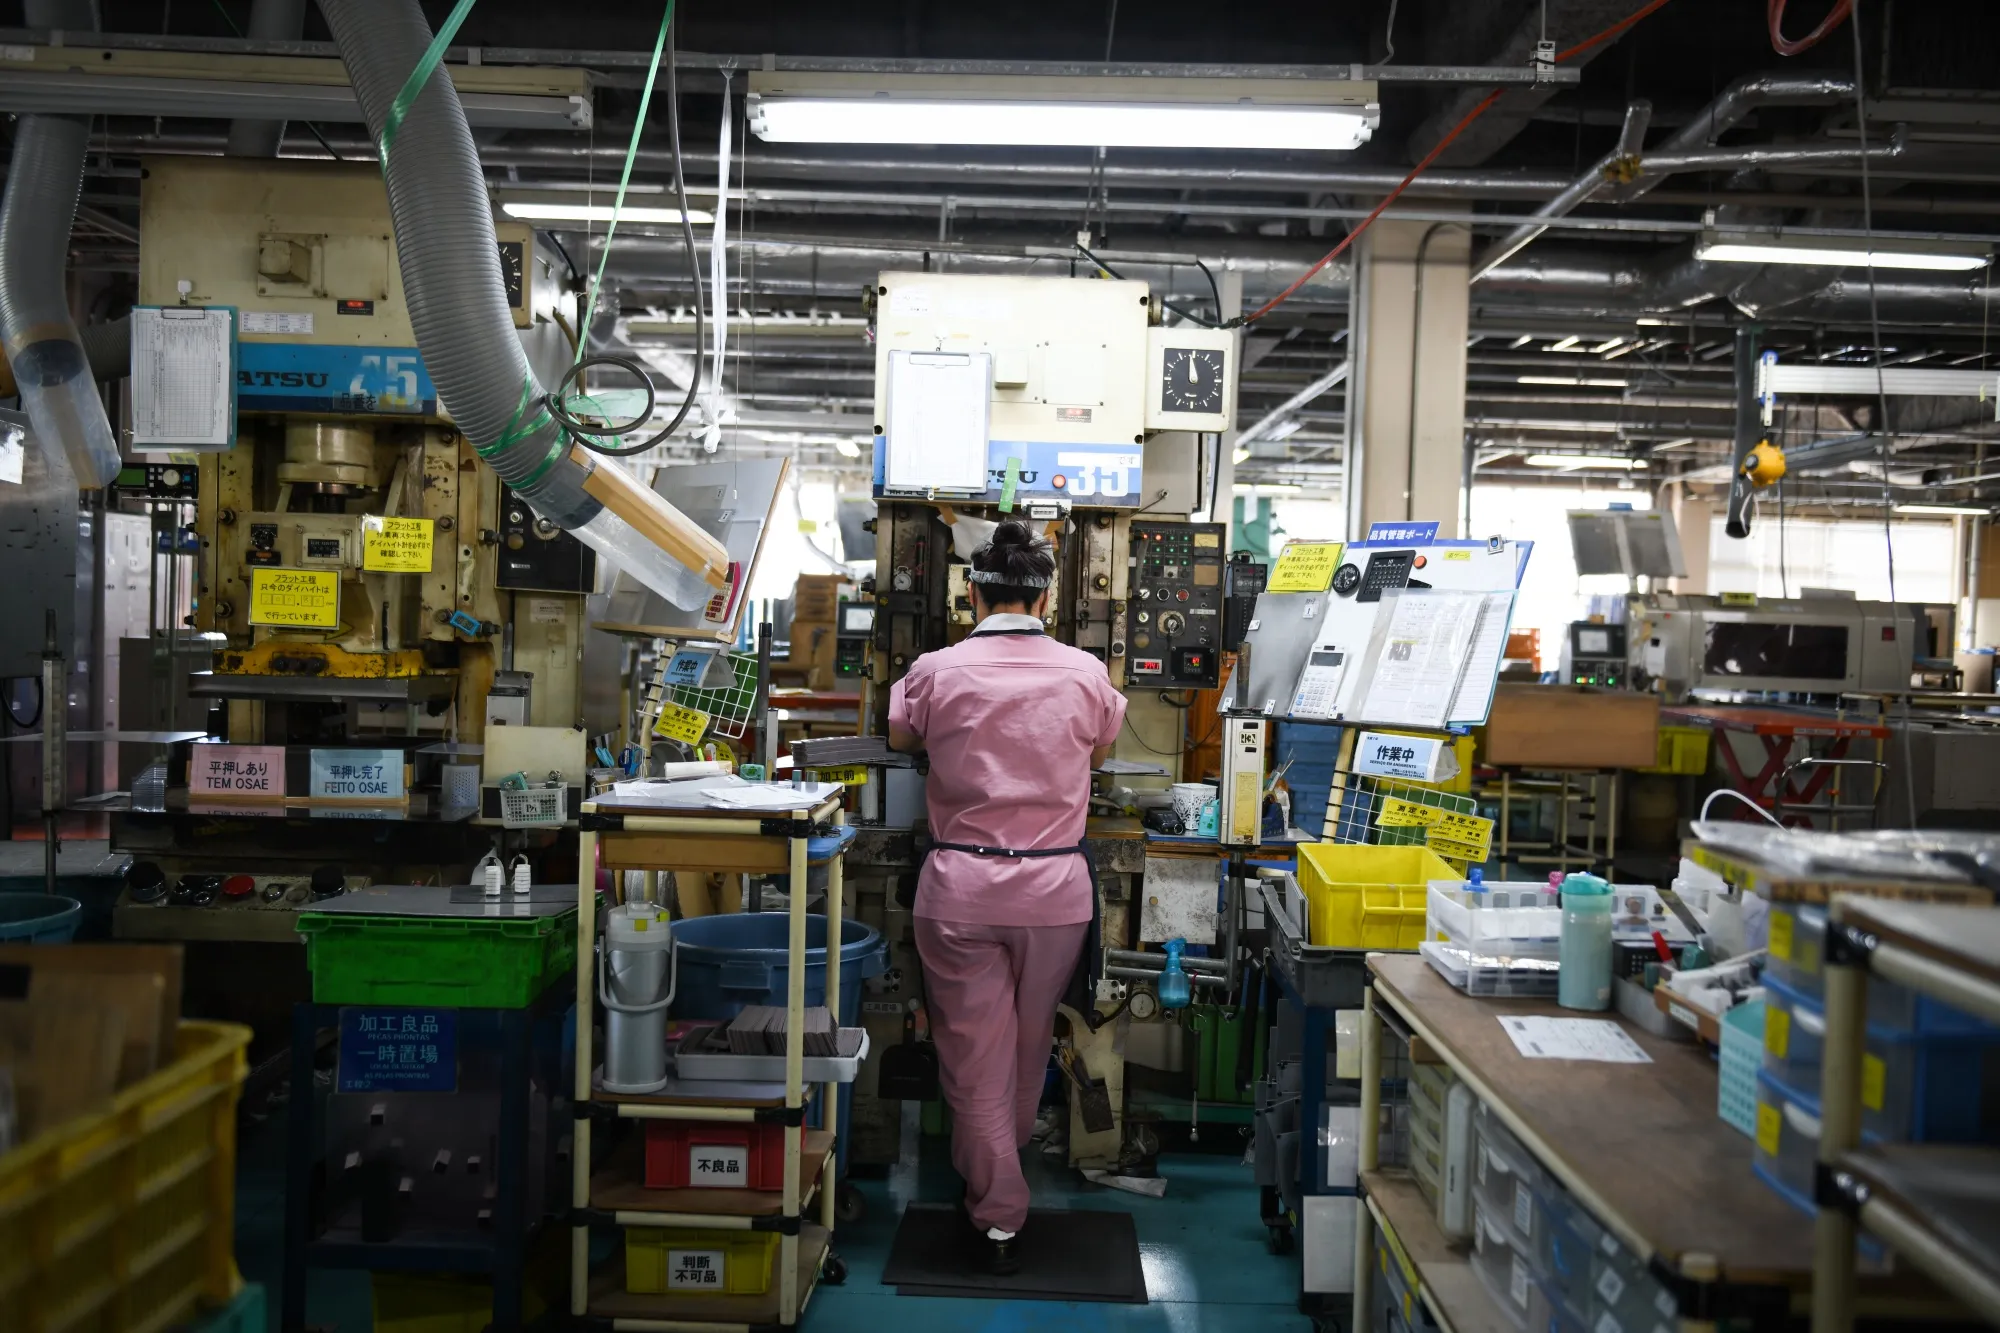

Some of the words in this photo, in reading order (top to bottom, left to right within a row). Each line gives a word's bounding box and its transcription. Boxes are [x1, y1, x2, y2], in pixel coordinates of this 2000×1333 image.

[350, 356, 417, 406] 45
[1068, 466, 1128, 497] 35
[387, 521, 422, 531] フラット工程
[1369, 529, 1434, 541] 品質管理ボード
[274, 574, 317, 585] フラット工程
[260, 583, 331, 594] 只今のダイハイトは
[263, 611, 322, 622] で行っています。
[1376, 744, 1415, 763] 作業中
[209, 760, 268, 776] 平押しあり
[329, 765, 384, 780] 平押し完了
[820, 769, 855, 781] 加工前
[206, 777, 232, 789] TEM
[235, 778, 269, 790] OSAE
[324, 781, 355, 794] FEITO
[359, 782, 388, 794] OSAE
[1396, 804, 1429, 817] 測定中
[1445, 814, 1478, 827] 測定中
[358, 1014, 439, 1034] 加工良品
[357, 1044, 439, 1064] 一時置場
[697, 1158, 740, 1174] 不良品
[682, 1255, 711, 1270] 判断
[675, 1269, 717, 1283] 不可品
